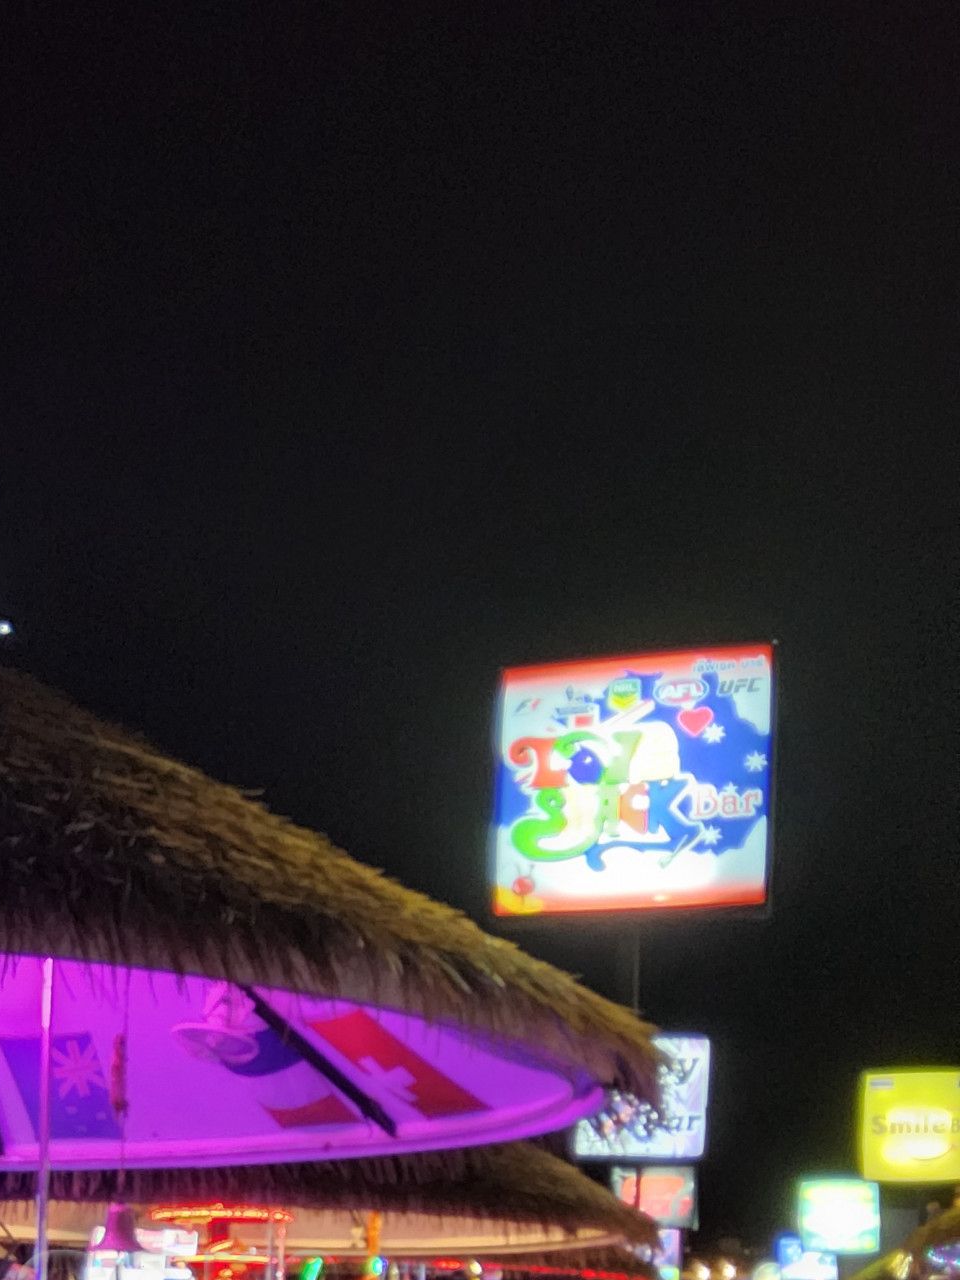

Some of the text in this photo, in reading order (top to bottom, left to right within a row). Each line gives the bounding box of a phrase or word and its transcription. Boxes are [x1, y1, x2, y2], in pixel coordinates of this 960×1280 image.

[718, 676, 763, 694] UFC
[692, 788, 761, 818] Bar
[871, 1113, 947, 1135] Smile
